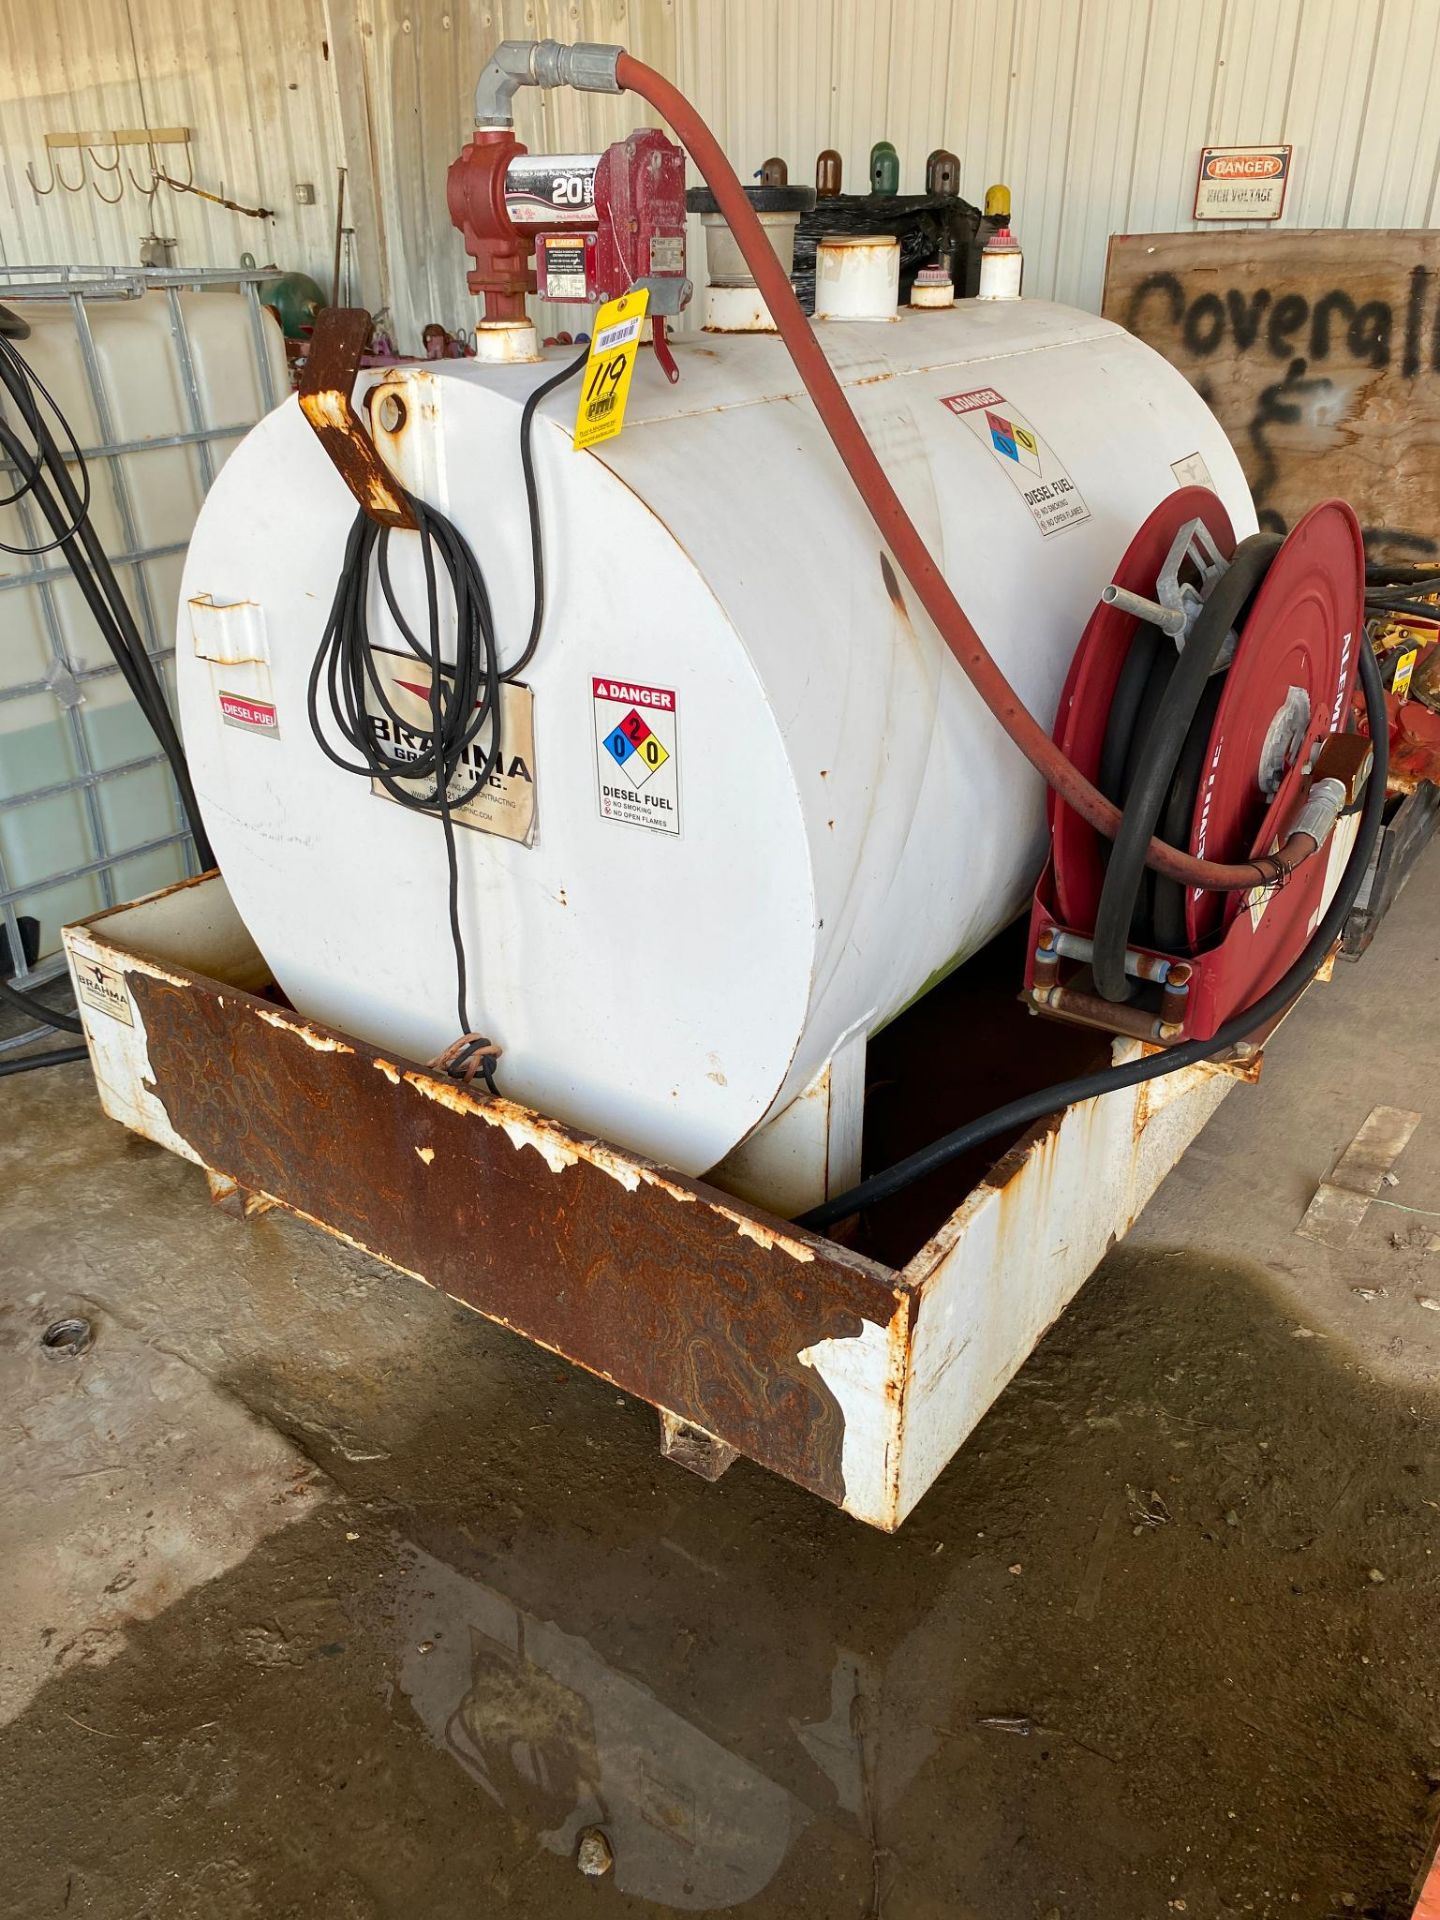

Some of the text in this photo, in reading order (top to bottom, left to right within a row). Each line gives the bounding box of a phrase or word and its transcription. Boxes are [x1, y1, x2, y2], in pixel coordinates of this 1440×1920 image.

[1214, 160, 1275, 174] DANGER
[552, 177, 583, 204] 20
[1206, 188, 1273, 203] HIGH VOLTAGE
[586, 353, 627, 402] 119
[955, 390, 1003, 411] DANGER
[991, 415, 1009, 433] 2
[997, 429, 1033, 454] 0 0
[1024, 478, 1074, 506] DIESEL FUEL
[1040, 499, 1069, 515] NO SMOKING
[1046, 518, 1055, 527] NO
[1054, 514, 1067, 524] OPEN
[1065, 505, 1084, 519] FLAMES
[609, 684, 672, 708] DANGER
[223, 702, 274, 726] DIESEL FUEL
[629, 717, 641, 741] 2
[367, 714, 533, 783] BRAMA
[613, 734, 659, 765] 0 0
[603, 785, 673, 811] DIESEL FUEL
[613, 800, 652, 815] NO SMOKING
[623, 811, 641, 821] OPEN
[641, 815, 667, 828] FLAMES
[78, 974, 128, 1005] BRAHMA
